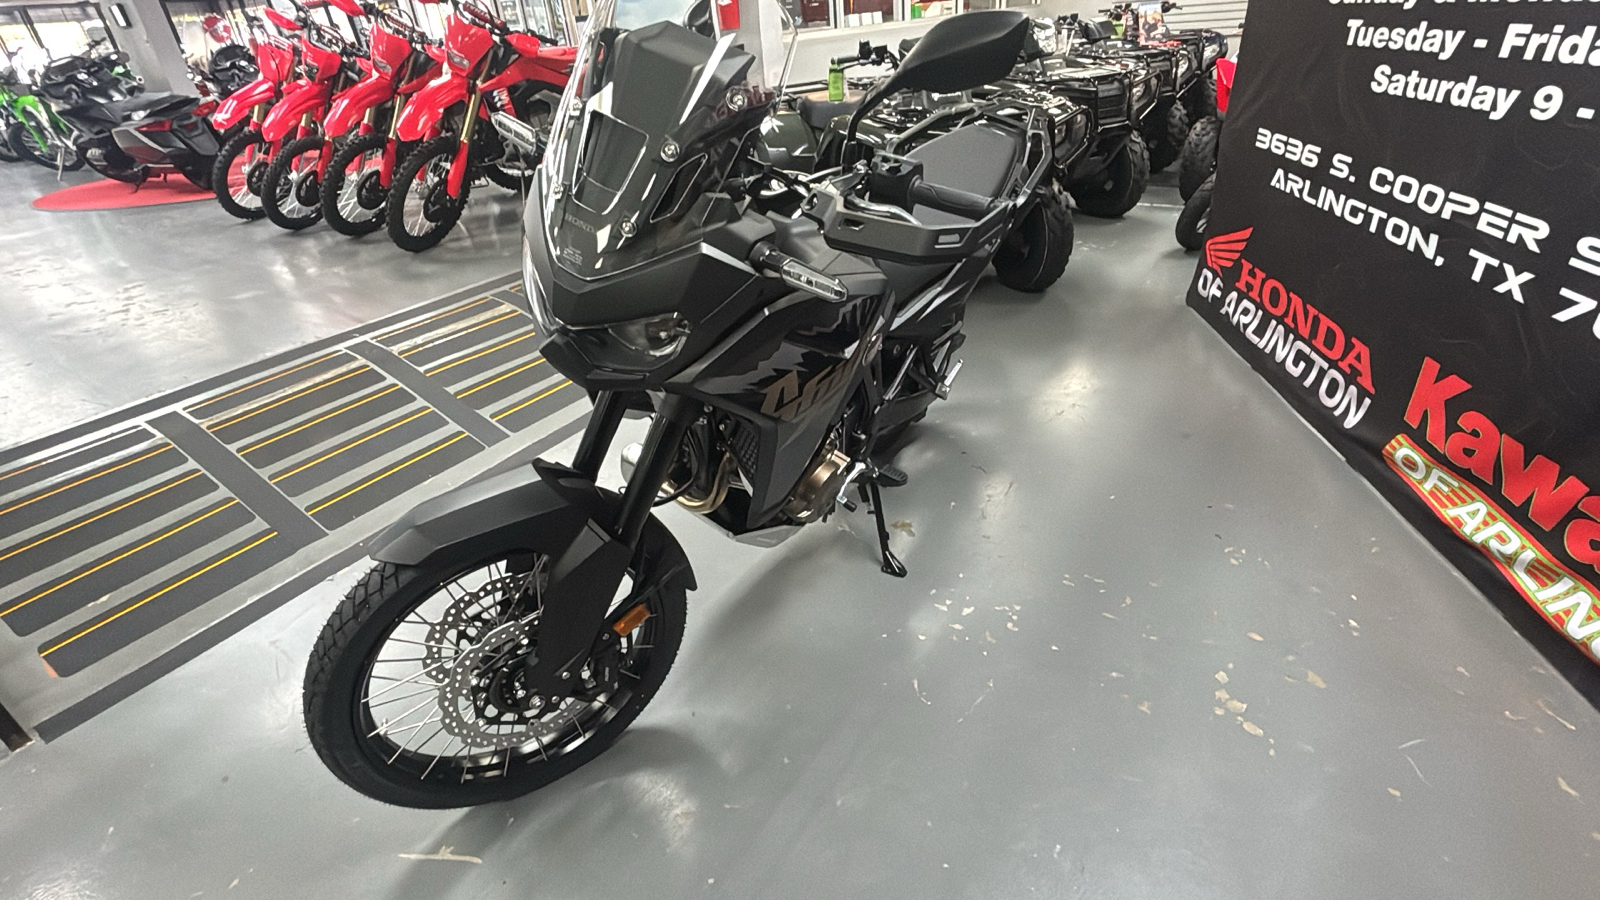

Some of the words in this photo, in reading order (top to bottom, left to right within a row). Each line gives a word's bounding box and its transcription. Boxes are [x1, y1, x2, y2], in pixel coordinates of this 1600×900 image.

[1346, 18, 1466, 60] Tuesday
[1473, 38, 1488, 49] -
[1370, 64, 1521, 120] Saturday
[1530, 85, 1564, 121] 9
[1576, 106, 1596, 120] -
[1255, 127, 1321, 168] 3636
[1329, 153, 1356, 183] S.
[1369, 166, 1550, 254] COOPER
[1270, 168, 1446, 267] ARLINGTON,
[1468, 249, 1536, 304] TX
[1551, 287, 1600, 340] 7
[1197, 267, 1224, 303] OF
[1219, 290, 1372, 429] ARLINGTON
[1235, 257, 1375, 394] HONDA
[1393, 446, 1459, 494] OF
[1445, 501, 1600, 659] ARLIN
